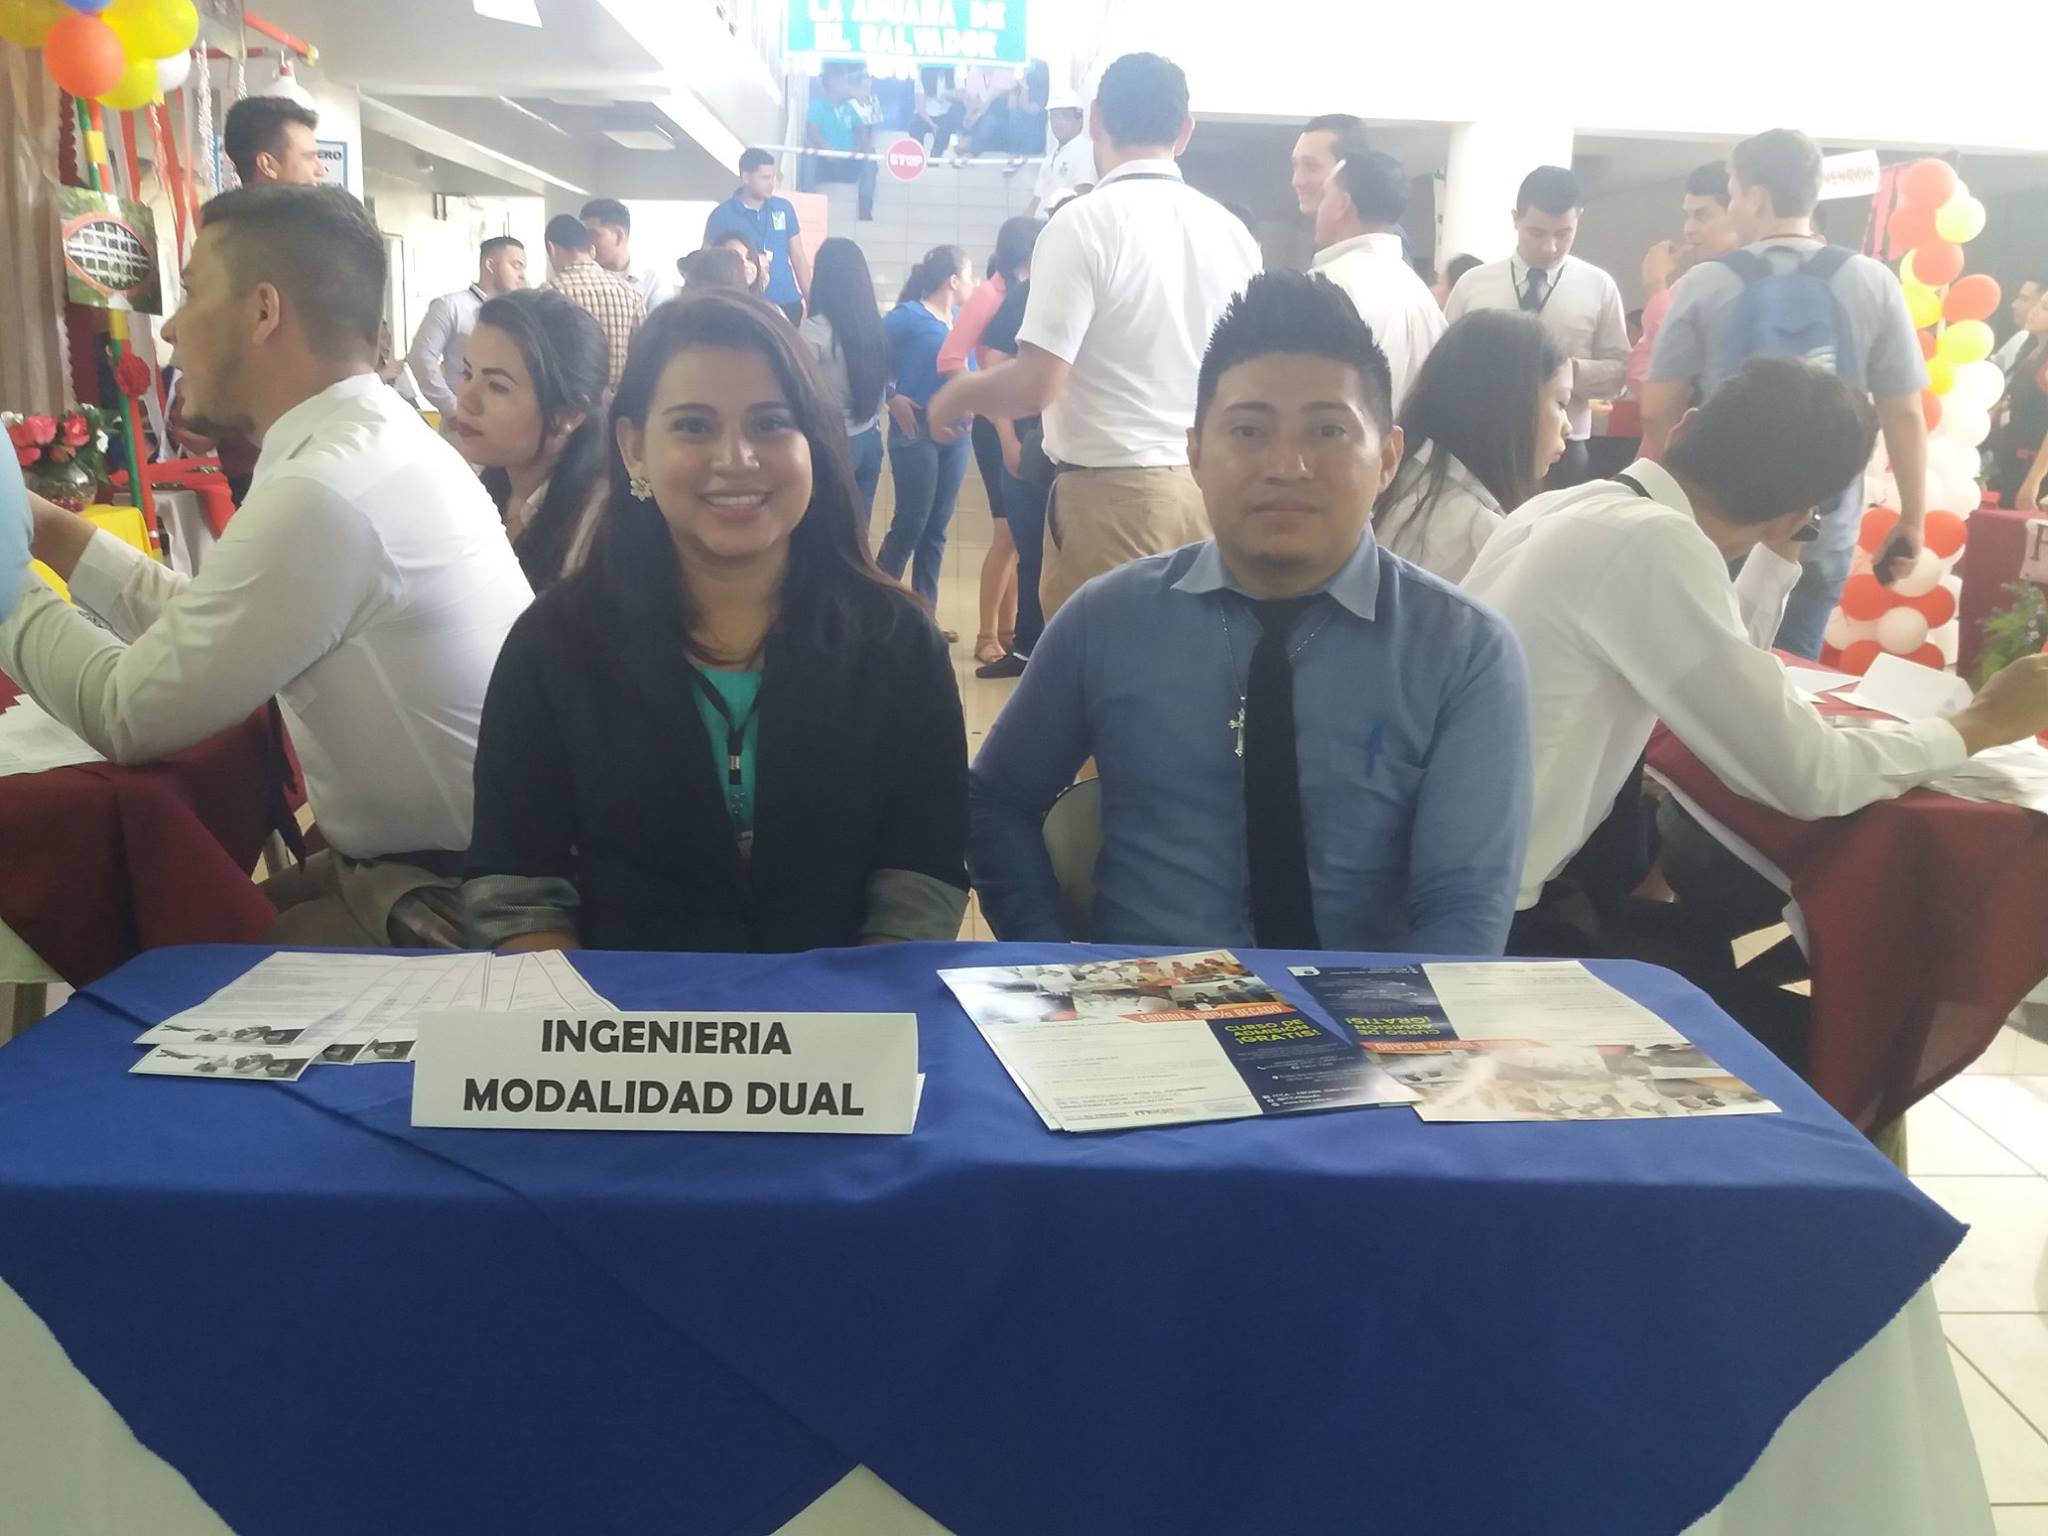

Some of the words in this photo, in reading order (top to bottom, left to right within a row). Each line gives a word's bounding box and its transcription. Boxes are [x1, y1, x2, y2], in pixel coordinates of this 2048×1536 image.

[815, 22, 851, 50] EL
[861, 24, 997, 58] SALVADOR
[890, 153, 922, 167] STOP
[1139, 1012, 1189, 1023] ESTUDIA
[1234, 1005, 1282, 1017] BECADO
[1224, 1022, 1278, 1032] CURSO
[1281, 1018, 1305, 1027] DE
[541, 1019, 792, 1055] INGENIERIA
[463, 1077, 734, 1115] MODALIDAD
[746, 1081, 864, 1116] DUAL
